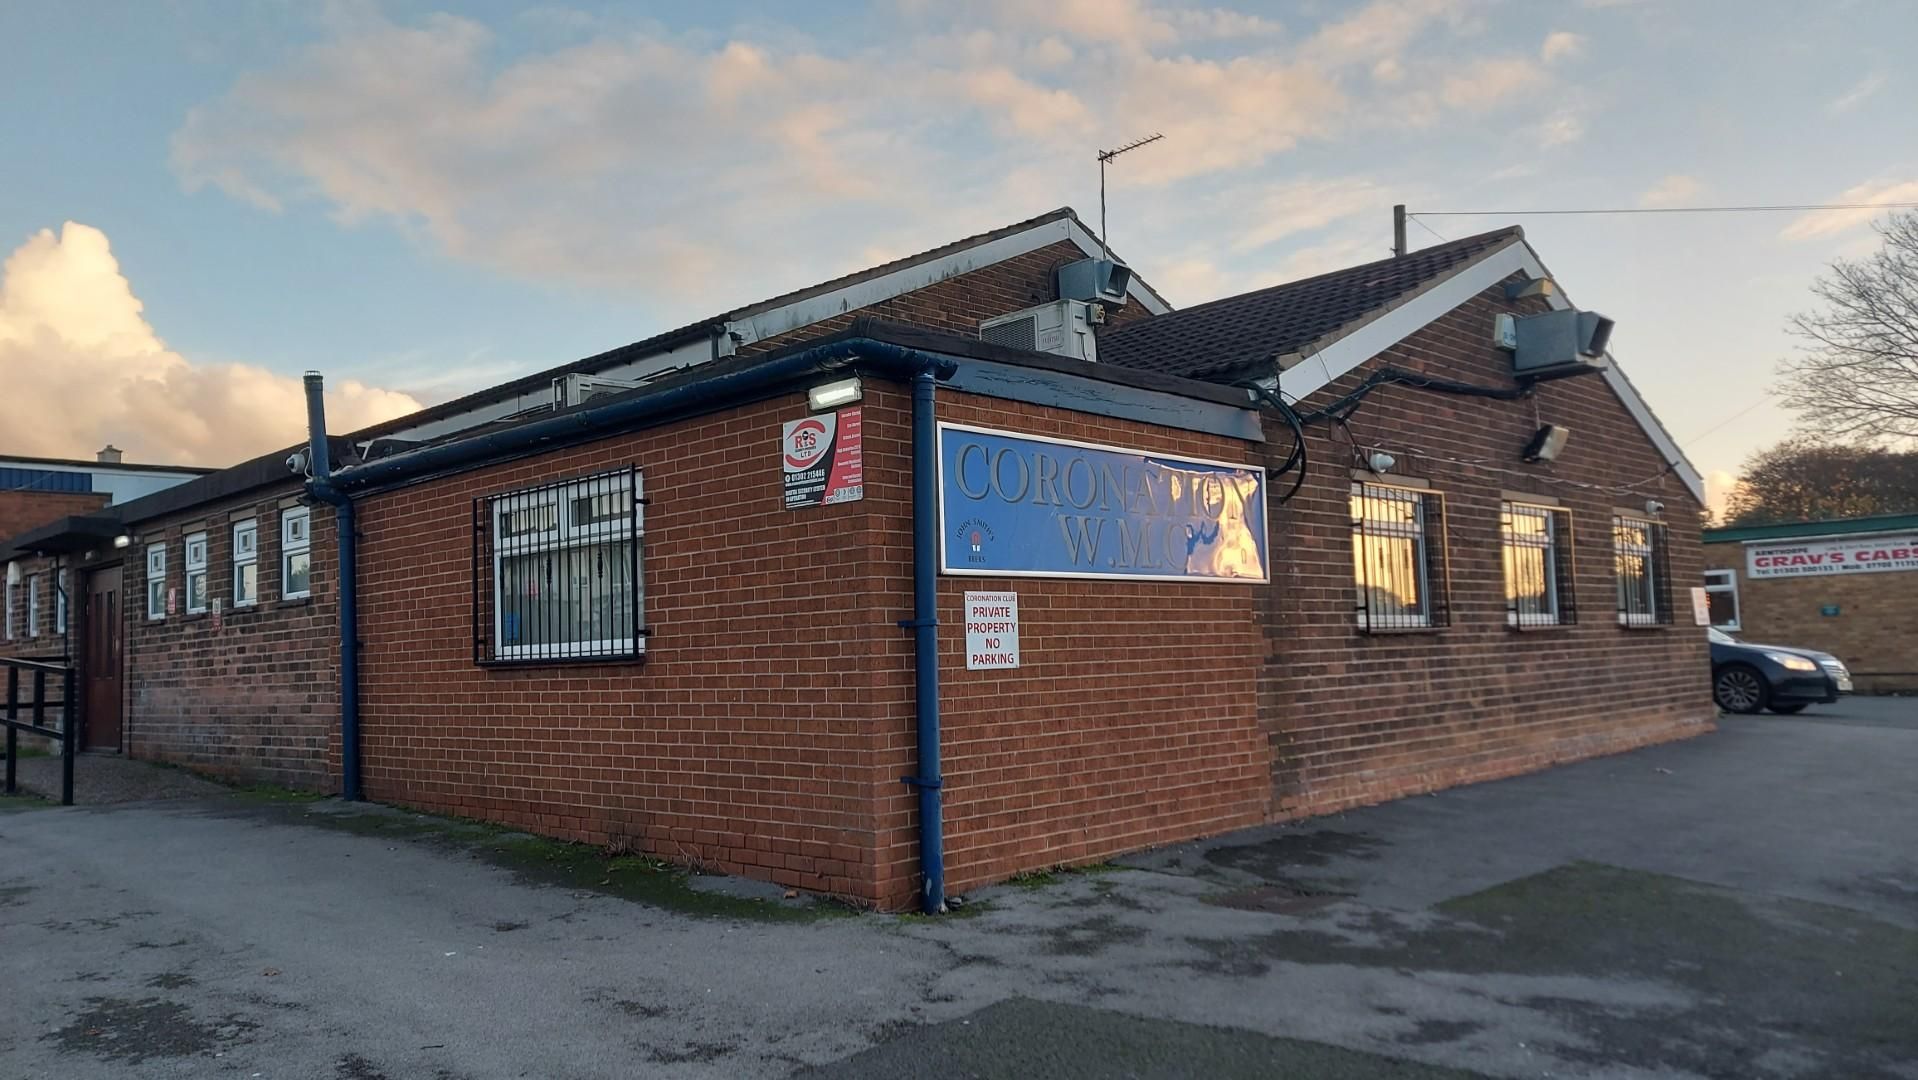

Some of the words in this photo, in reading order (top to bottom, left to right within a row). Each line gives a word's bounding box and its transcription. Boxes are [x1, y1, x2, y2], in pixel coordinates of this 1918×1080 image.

[954, 442, 1257, 521] CORONATION
[1755, 552, 1845, 567] GRAV'S
[1002, 594, 1016, 602] CLUB
[972, 606, 1011, 618] PRIVATE
[967, 622, 1017, 634] PROPERTY
[985, 638, 1000, 649] NO
[972, 653, 1014, 665] PARKING
